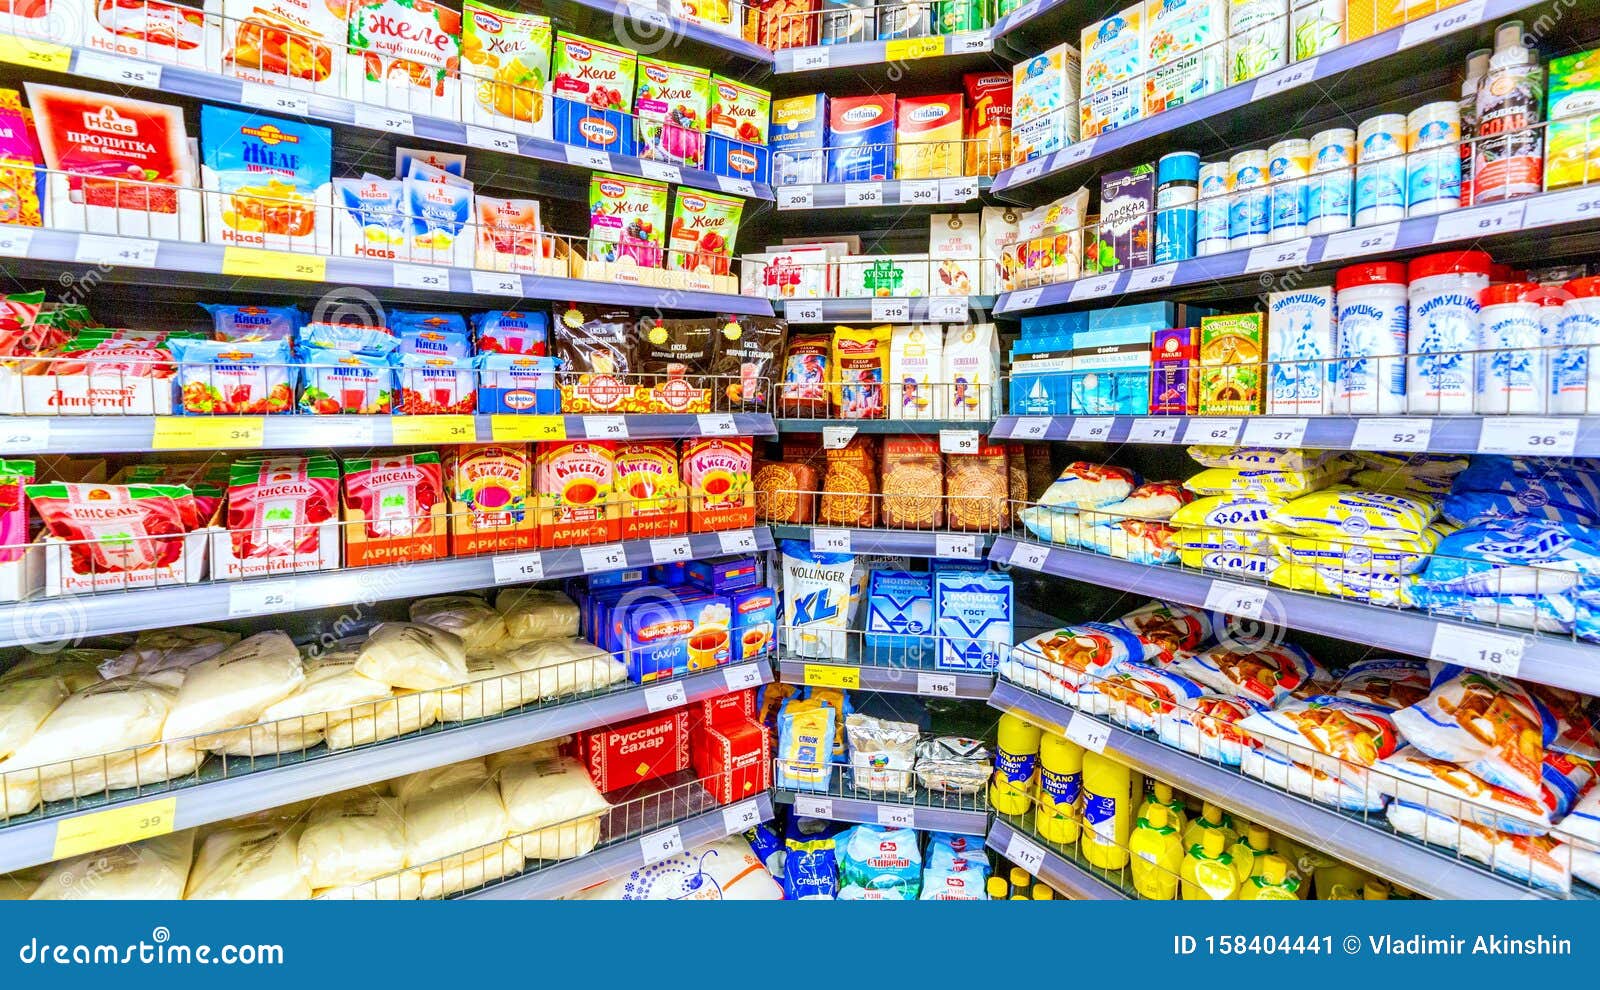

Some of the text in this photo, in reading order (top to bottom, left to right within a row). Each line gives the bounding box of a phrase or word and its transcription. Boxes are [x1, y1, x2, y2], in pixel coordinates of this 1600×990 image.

[1431, 13, 1467, 32] 108
[369, 14, 449, 51] Желе
[91, 36, 138, 55] Haas
[921, 44, 937, 52] 169
[966, 40, 984, 48] 299
[29, 52, 52, 63] 25
[577, 65, 616, 80] Желе
[1156, 56, 1197, 79] Sea Salt
[121, 70, 145, 81] 35
[1276, 72, 1301, 87] 148
[656, 87, 692, 100] Желе
[1092, 86, 1129, 105] Sea Salt
[277, 99, 296, 108] 35
[728, 105, 756, 117] Желе
[88, 116, 133, 133] Haas
[1480, 115, 1528, 135] СОЛЬ
[67, 131, 157, 154] ПРОПИТКА
[859, 192, 876, 200] 303
[954, 188, 972, 196] 345
[611, 201, 649, 215] Желе
[690, 215, 725, 229] Желе
[1478, 218, 1503, 228] 81
[222, 230, 263, 244] Haas
[1360, 238, 1381, 247] 52
[355, 244, 396, 259] Haas
[1277, 252, 1296, 262] 52
[296, 265, 314, 274] 25
[499, 282, 514, 290] 23
[1094, 284, 1106, 292] 59
[1272, 294, 1326, 312] ЗИМУШКА
[1417, 294, 1482, 317] ЗИМУШКА
[885, 308, 902, 316] 219
[1029, 426, 1041, 434] 59
[1090, 427, 1103, 435] 59
[1152, 429, 1166, 438] 71
[1211, 430, 1227, 438] 62
[1274, 432, 1292, 440] 37
[1392, 434, 1416, 443] 52
[1528, 436, 1556, 446] 36
[960, 440, 971, 448] 99
[371, 471, 416, 485] КИСЕЛЬ
[257, 485, 308, 498] КИСЕЛЬ
[73, 506, 138, 520] КИСЕЛЬ
[739, 539, 750, 547] 15
[606, 555, 618, 564] 15
[1028, 556, 1039, 564] 10
[520, 566, 533, 574] 15
[790, 566, 844, 582] WOLLINGER
[264, 595, 284, 604] 25
[793, 588, 839, 625] XL
[1236, 600, 1251, 610] 18
[1478, 650, 1501, 663] 18
[744, 674, 755, 682] 33
[932, 684, 949, 692] 196
[667, 693, 679, 702] 66
[609, 720, 673, 746] Русский
[1087, 733, 1098, 744] 11
[619, 736, 664, 755] сахар
[1001, 759, 1022, 768] LEMON
[1045, 778, 1068, 791] LEMON
[140, 815, 161, 829] 39
[742, 813, 754, 822] 32
[663, 841, 674, 850] 61
[1019, 850, 1035, 863] 117
